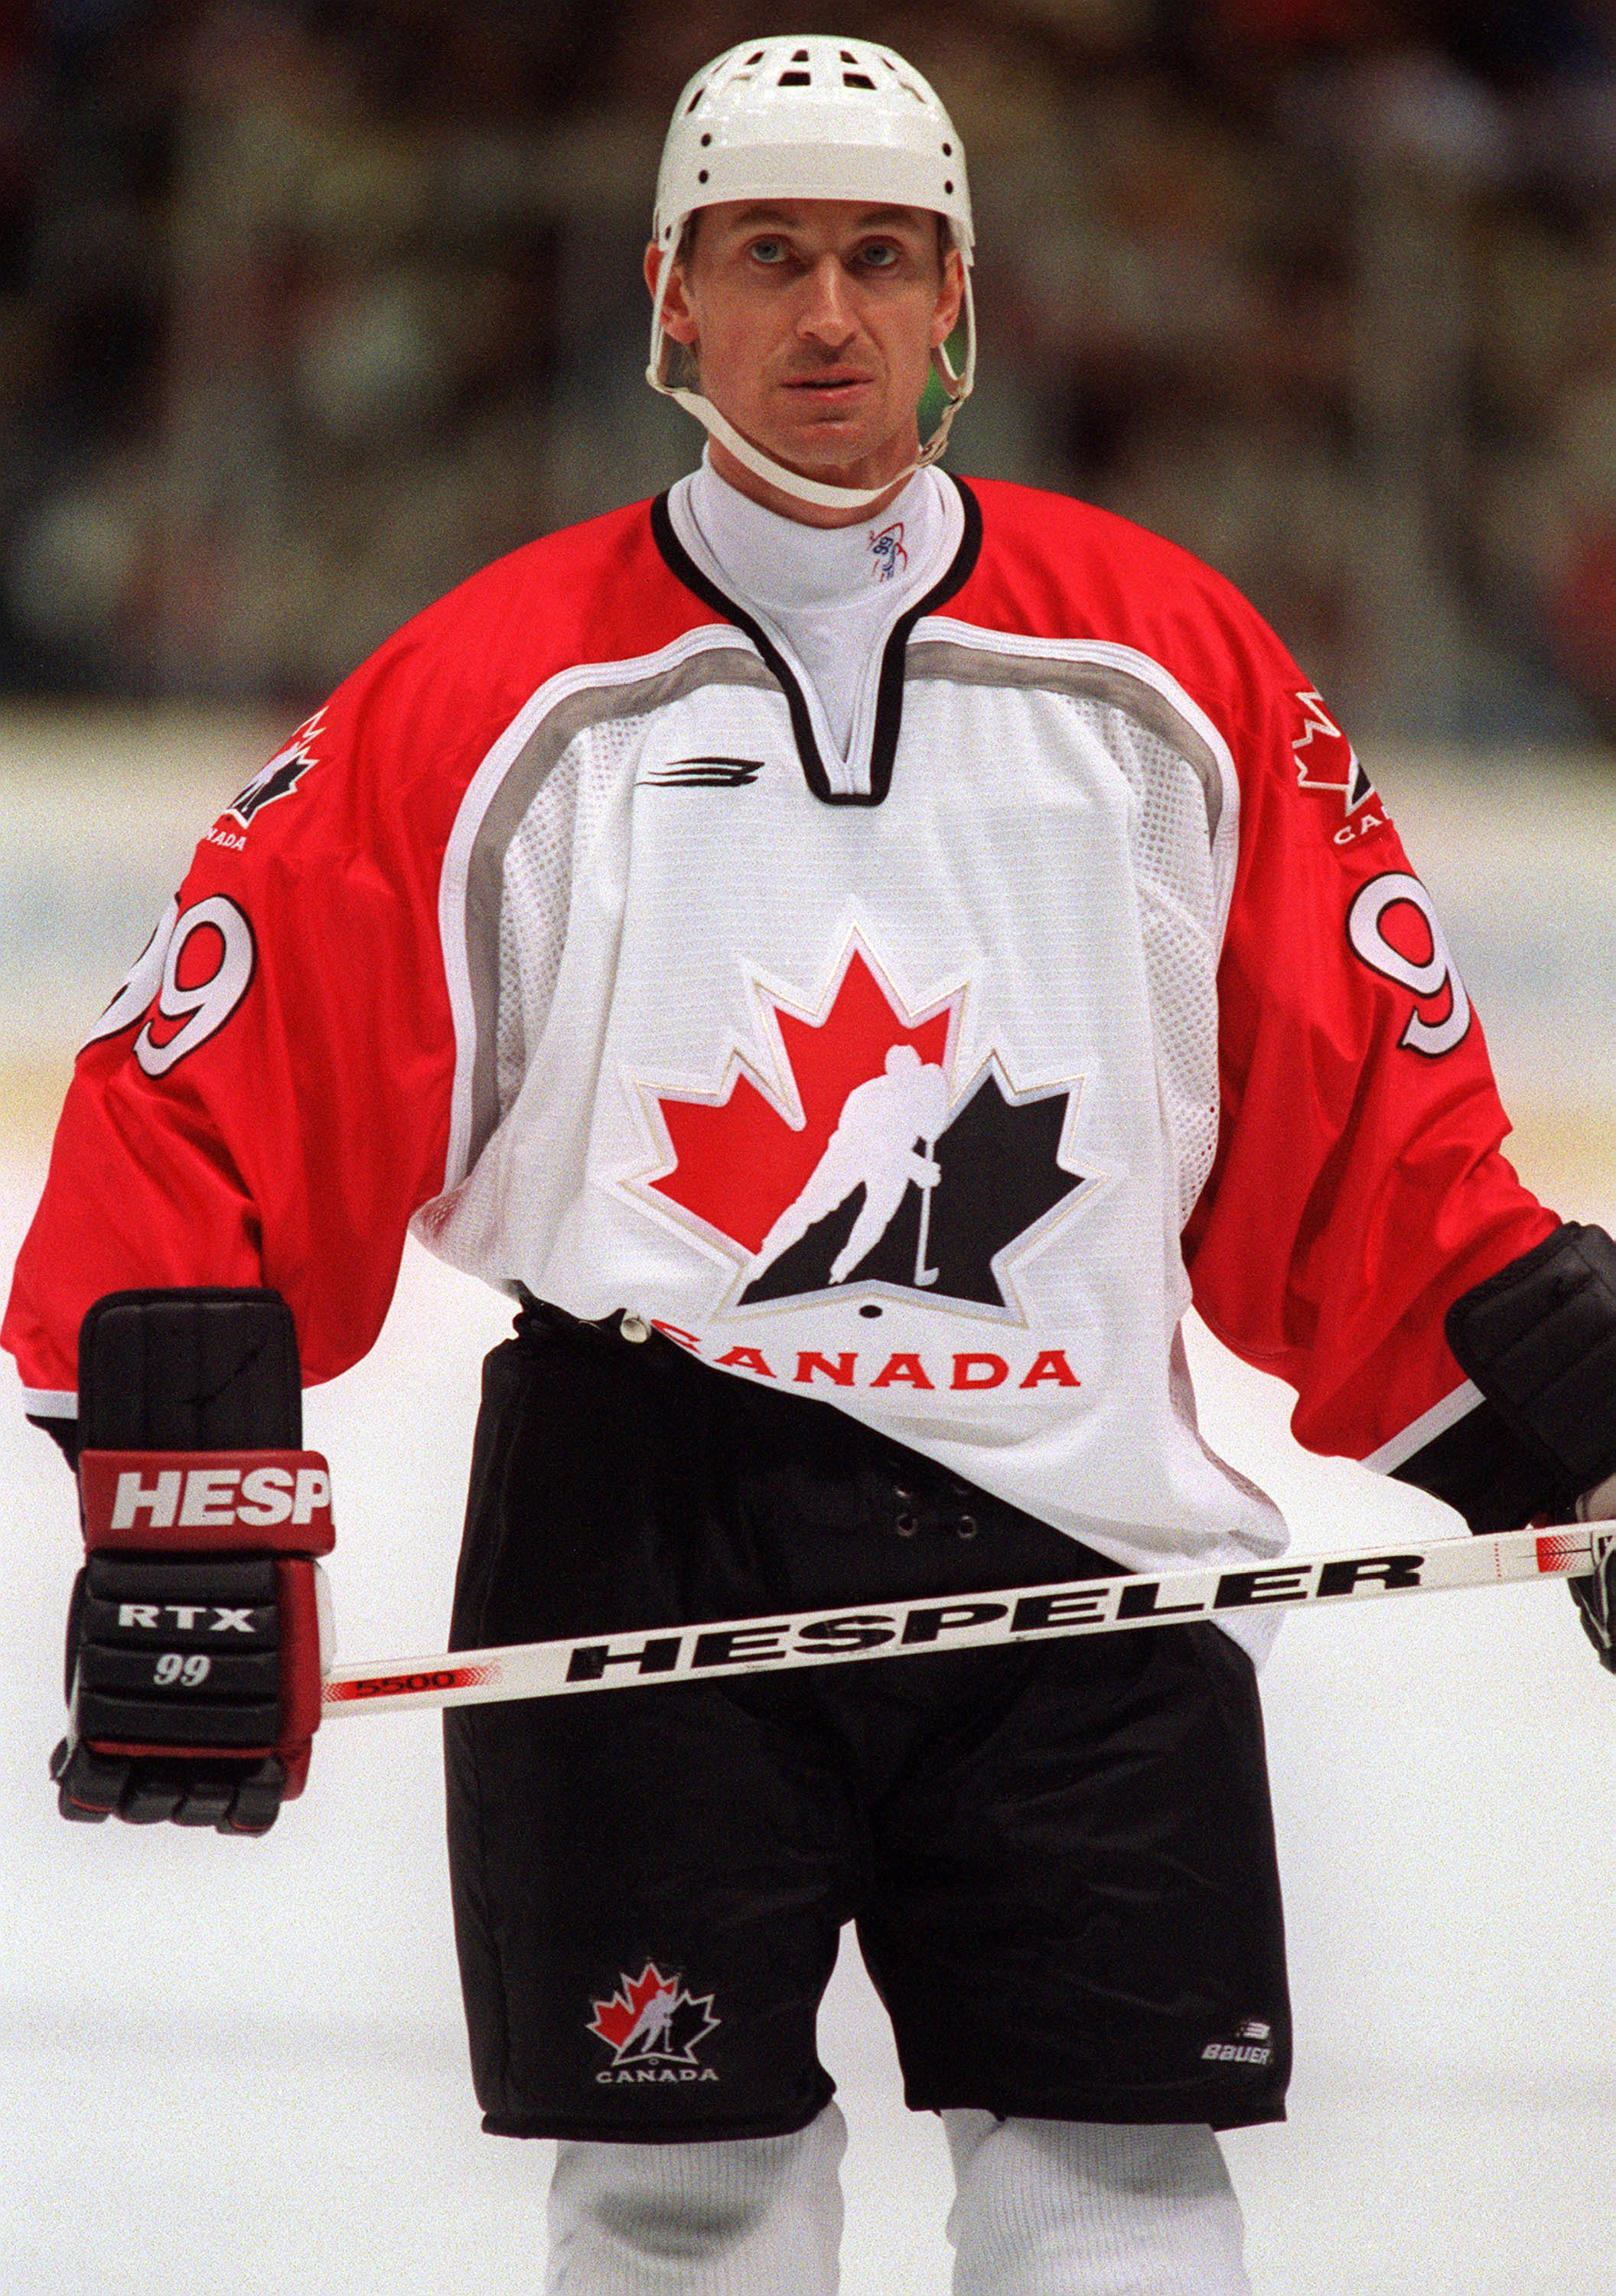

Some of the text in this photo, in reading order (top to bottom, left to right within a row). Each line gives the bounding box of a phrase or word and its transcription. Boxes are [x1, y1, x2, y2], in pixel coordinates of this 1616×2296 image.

[650, 1319, 1081, 1390] CANADA
[116, 1604, 256, 1633] RTX
[565, 1554, 1425, 1684] HESPELER
[153, 1653, 210, 1687] 99
[354, 1671, 456, 1697] 5500
[595, 2067, 720, 2084] CANADA
